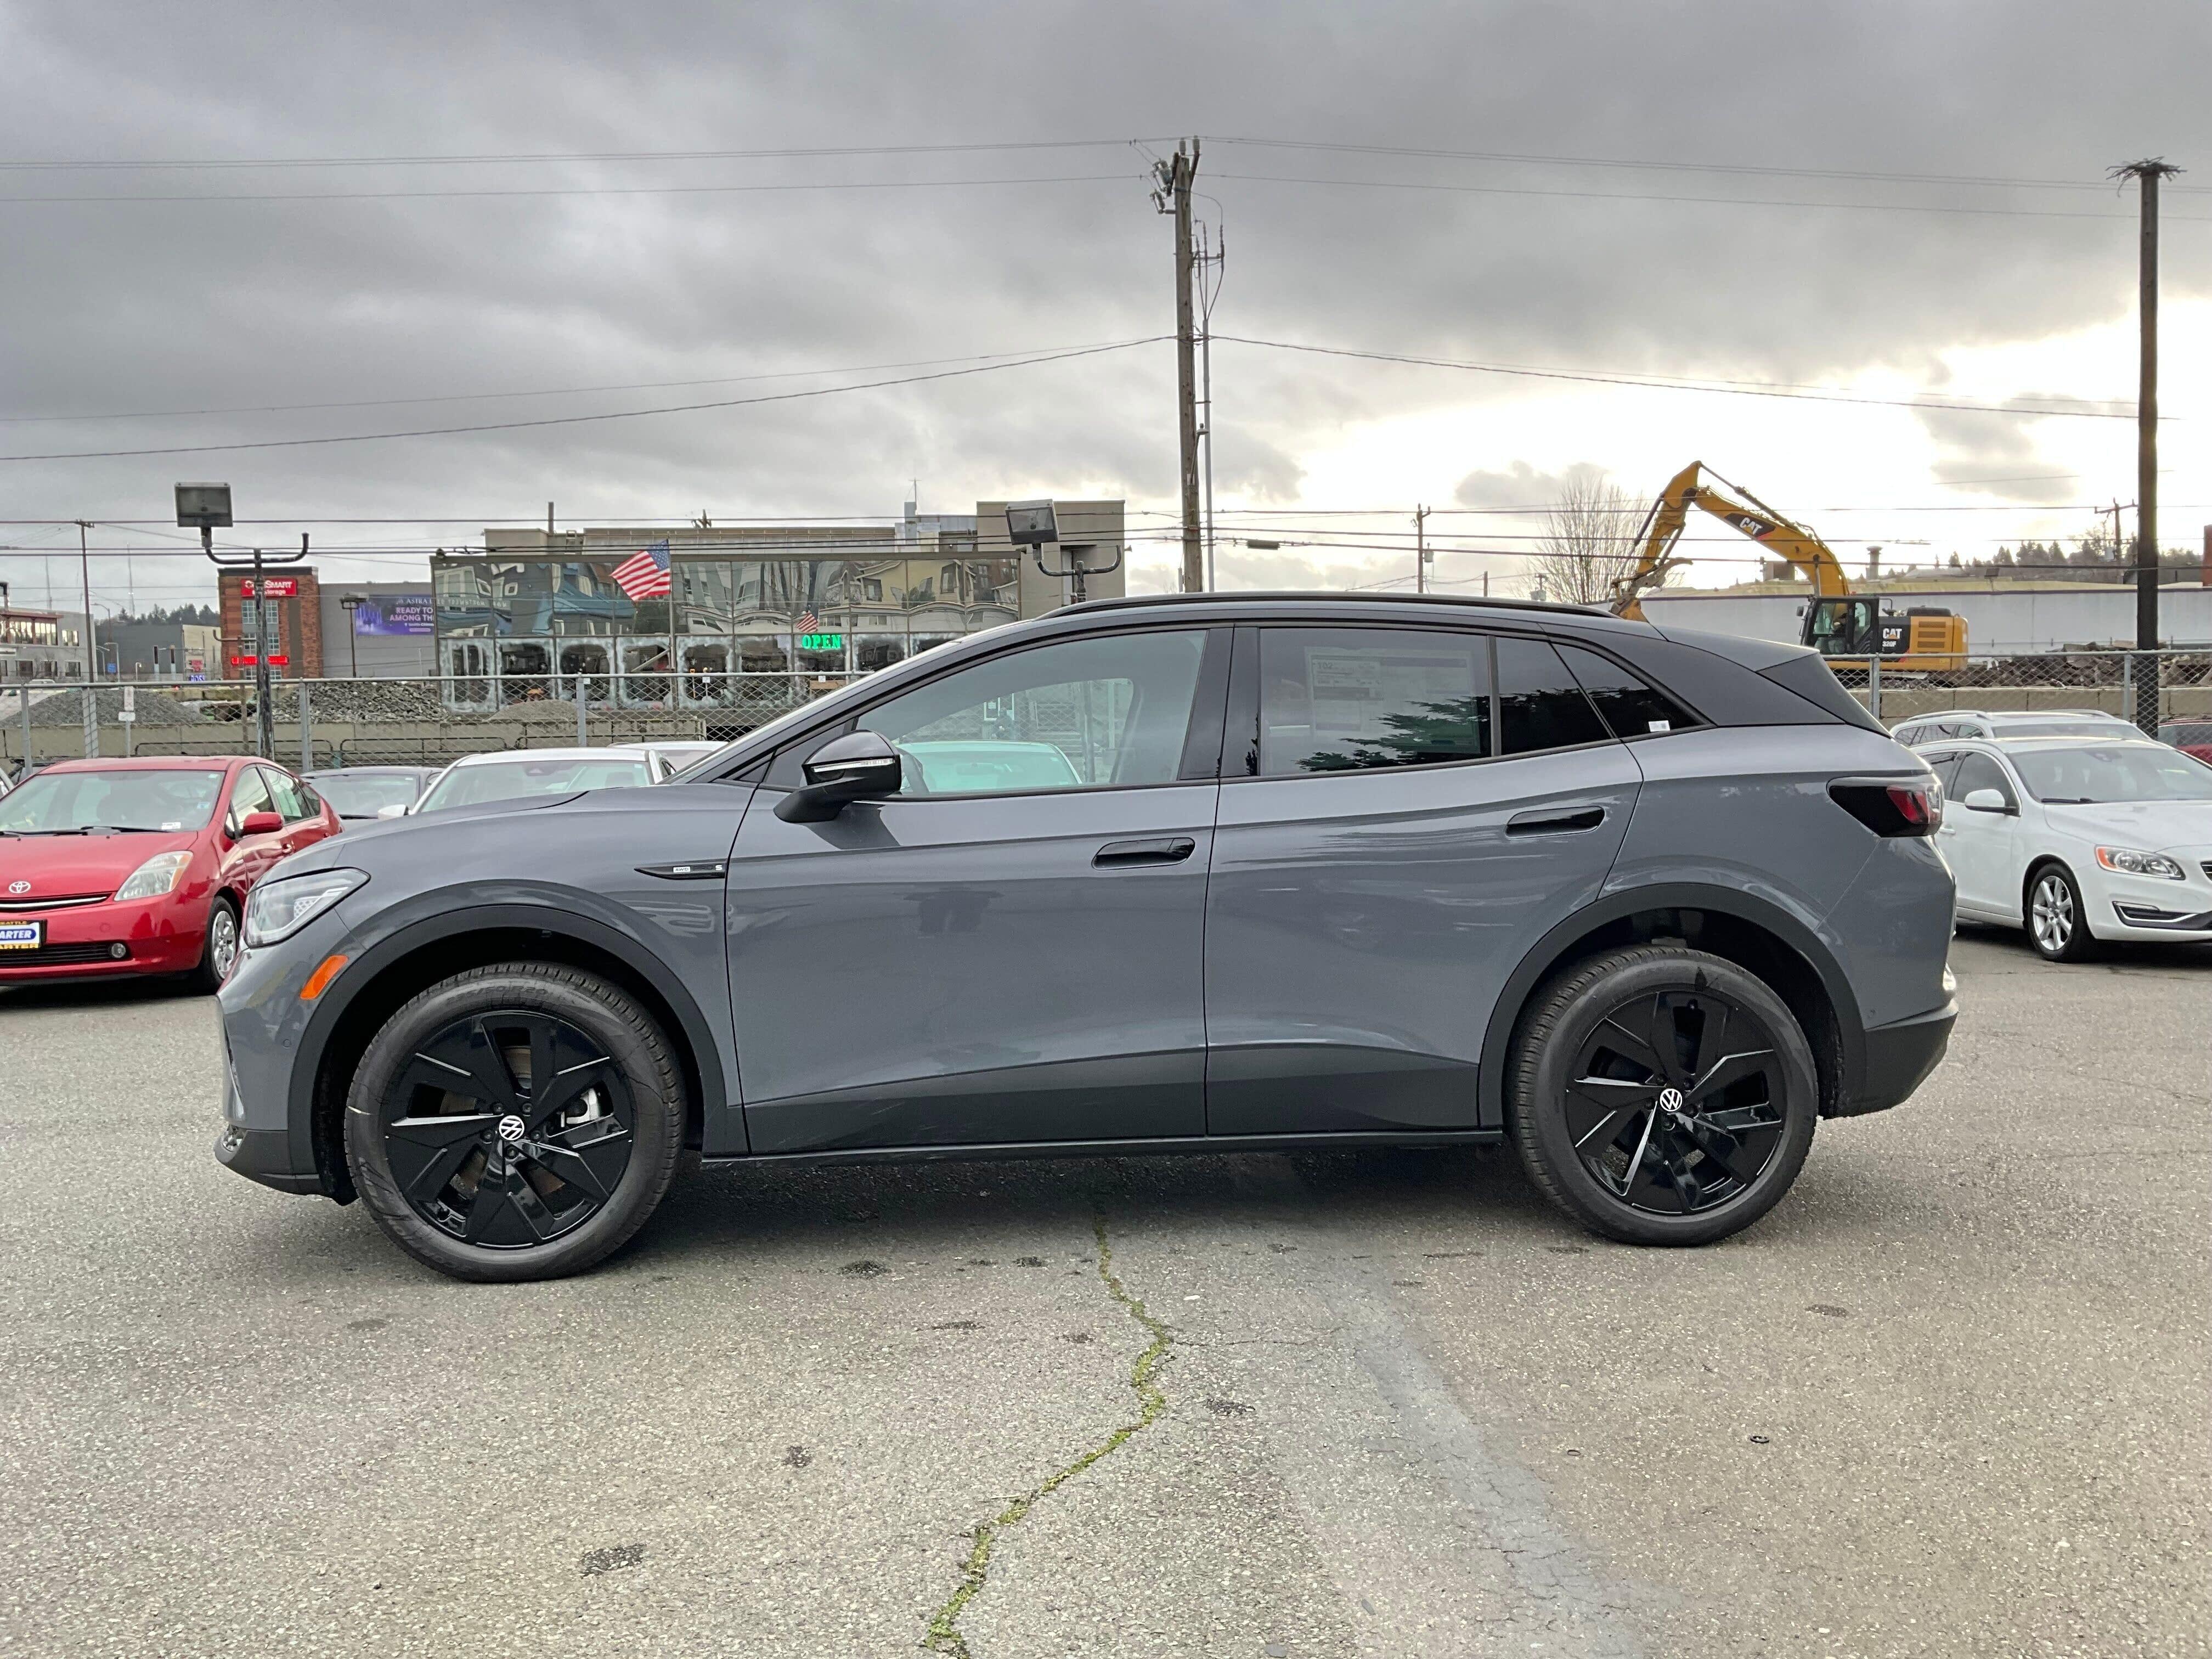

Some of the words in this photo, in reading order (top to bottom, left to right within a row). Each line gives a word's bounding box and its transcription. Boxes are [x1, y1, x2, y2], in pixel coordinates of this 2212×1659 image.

[1740, 517, 1763, 535] CAT
[1883, 628, 1902, 640] CAT
[802, 635, 841, 650] OPEN
